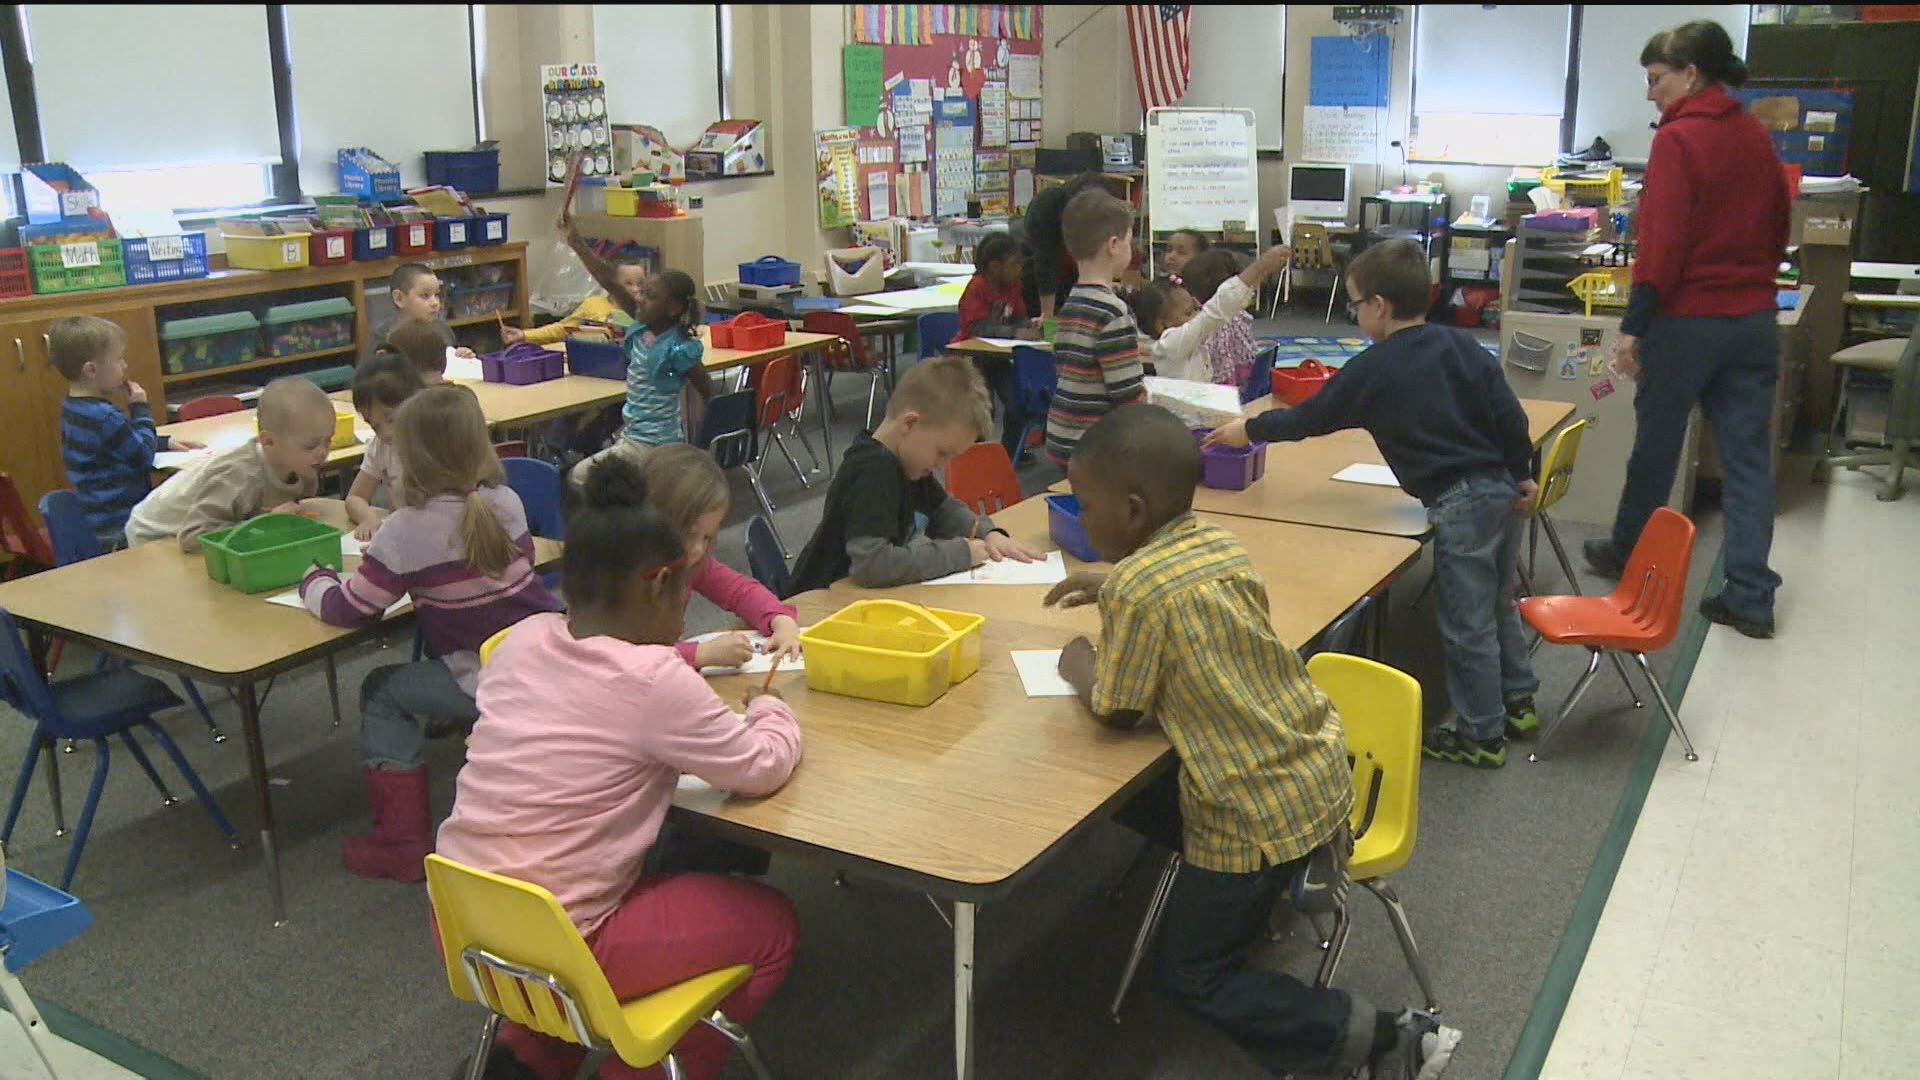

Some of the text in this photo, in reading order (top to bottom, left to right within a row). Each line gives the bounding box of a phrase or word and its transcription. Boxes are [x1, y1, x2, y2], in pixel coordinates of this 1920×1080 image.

[548, 67, 567, 77] OUR
[65, 245, 97, 265] Math
[287, 242, 297, 262] B
